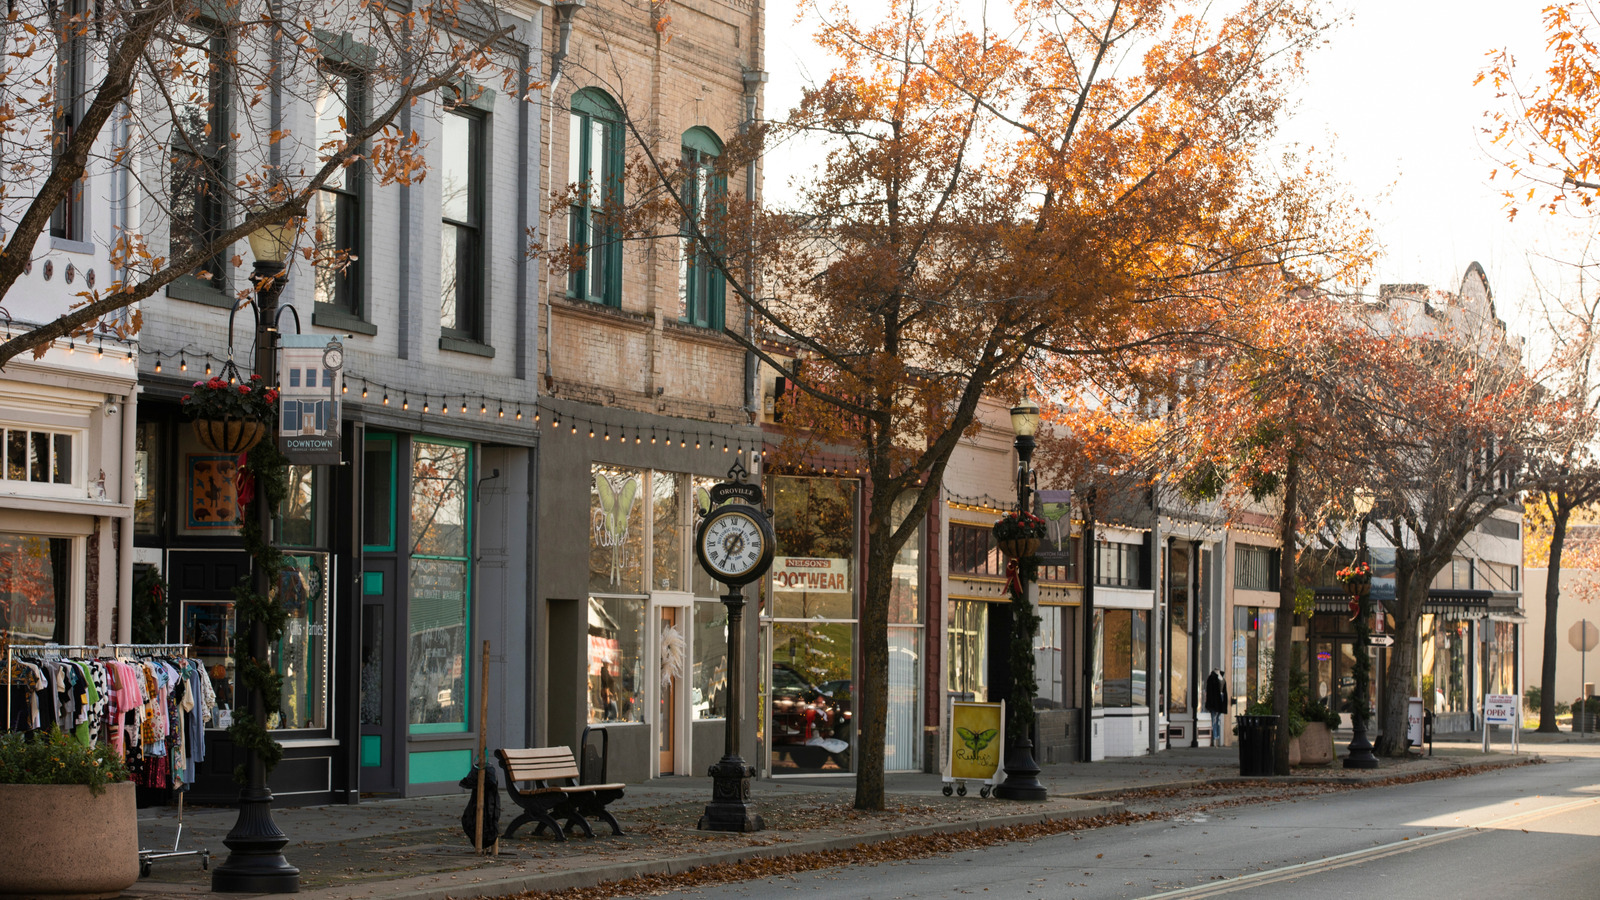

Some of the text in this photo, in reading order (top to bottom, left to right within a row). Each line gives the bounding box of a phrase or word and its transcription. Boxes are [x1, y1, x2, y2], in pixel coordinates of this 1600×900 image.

[287, 440, 333, 448] DOWNTOWN
[719, 488, 754, 497] OROVILLE
[788, 560, 829, 568] NELSON'S
[4, 600, 55, 624] COYOTE
